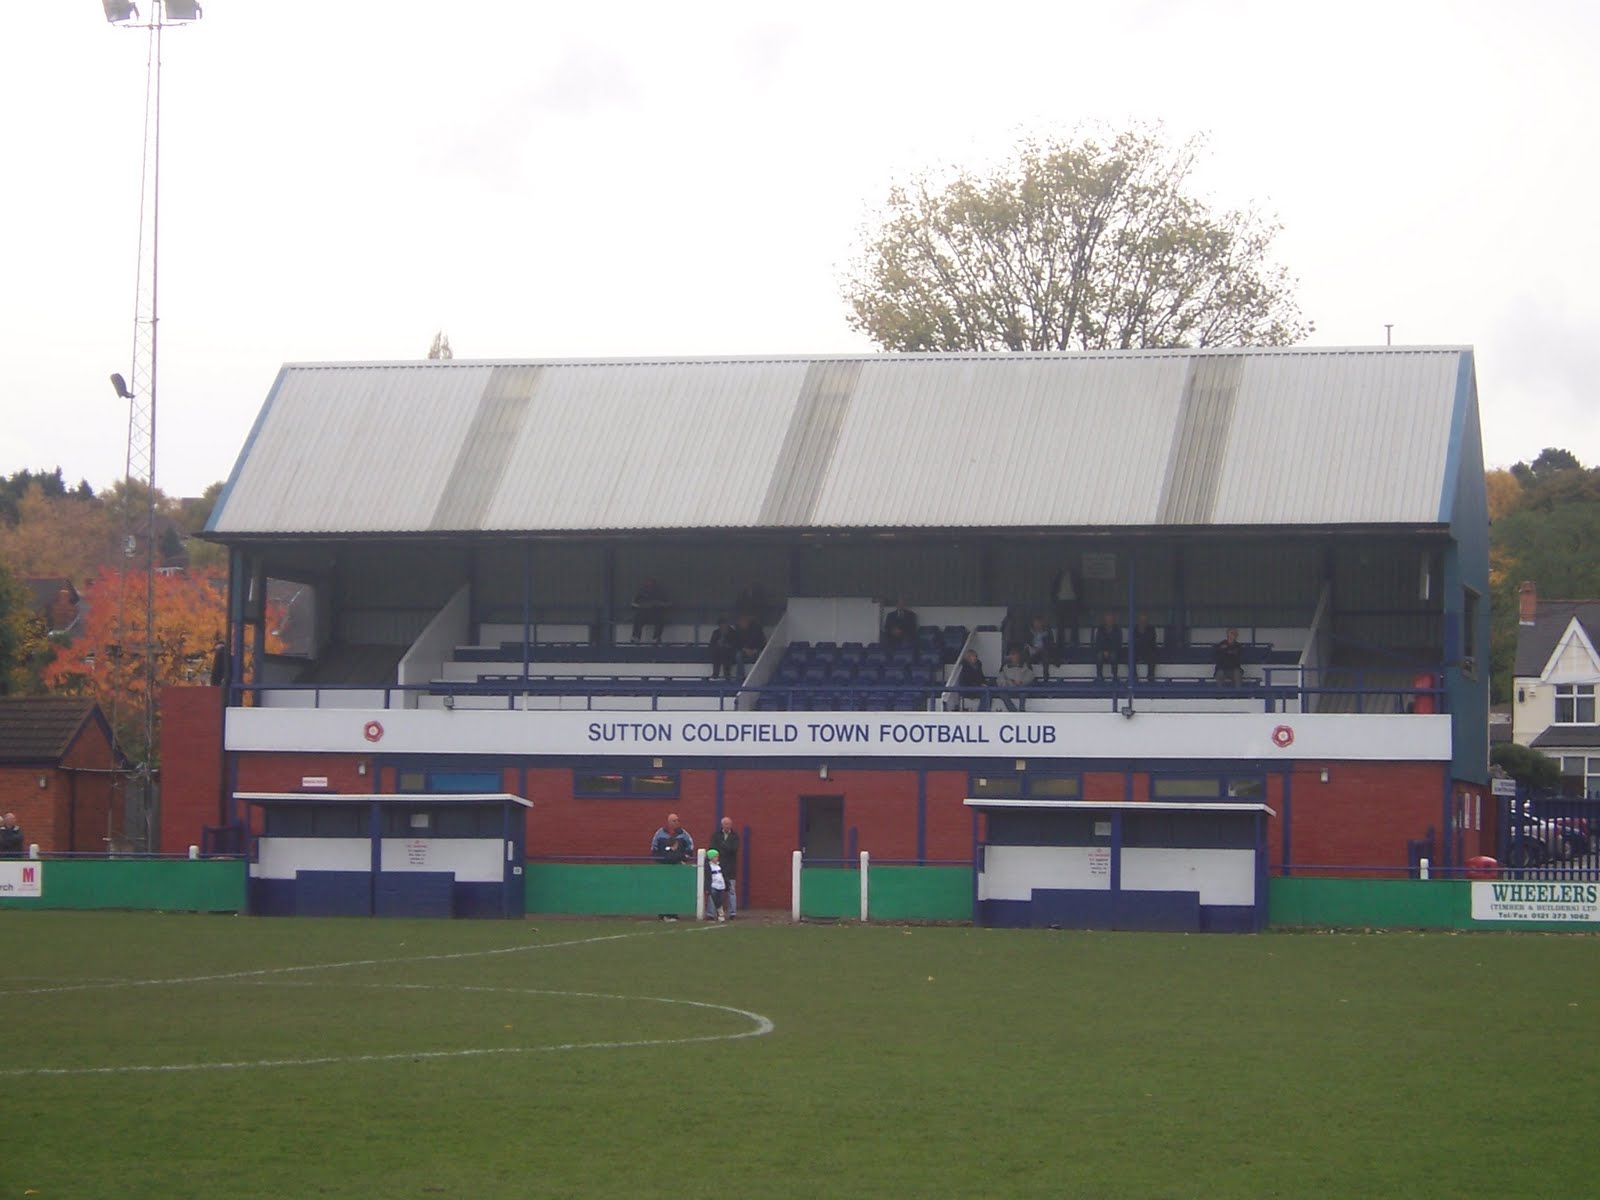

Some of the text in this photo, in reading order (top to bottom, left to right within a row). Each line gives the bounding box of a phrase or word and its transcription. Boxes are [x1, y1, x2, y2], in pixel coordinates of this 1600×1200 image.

[588, 723, 1056, 743] SUTTON COLDFIELD TOWN FOOTBALL CLUB
[1492, 884, 1597, 903] WHEELERS
